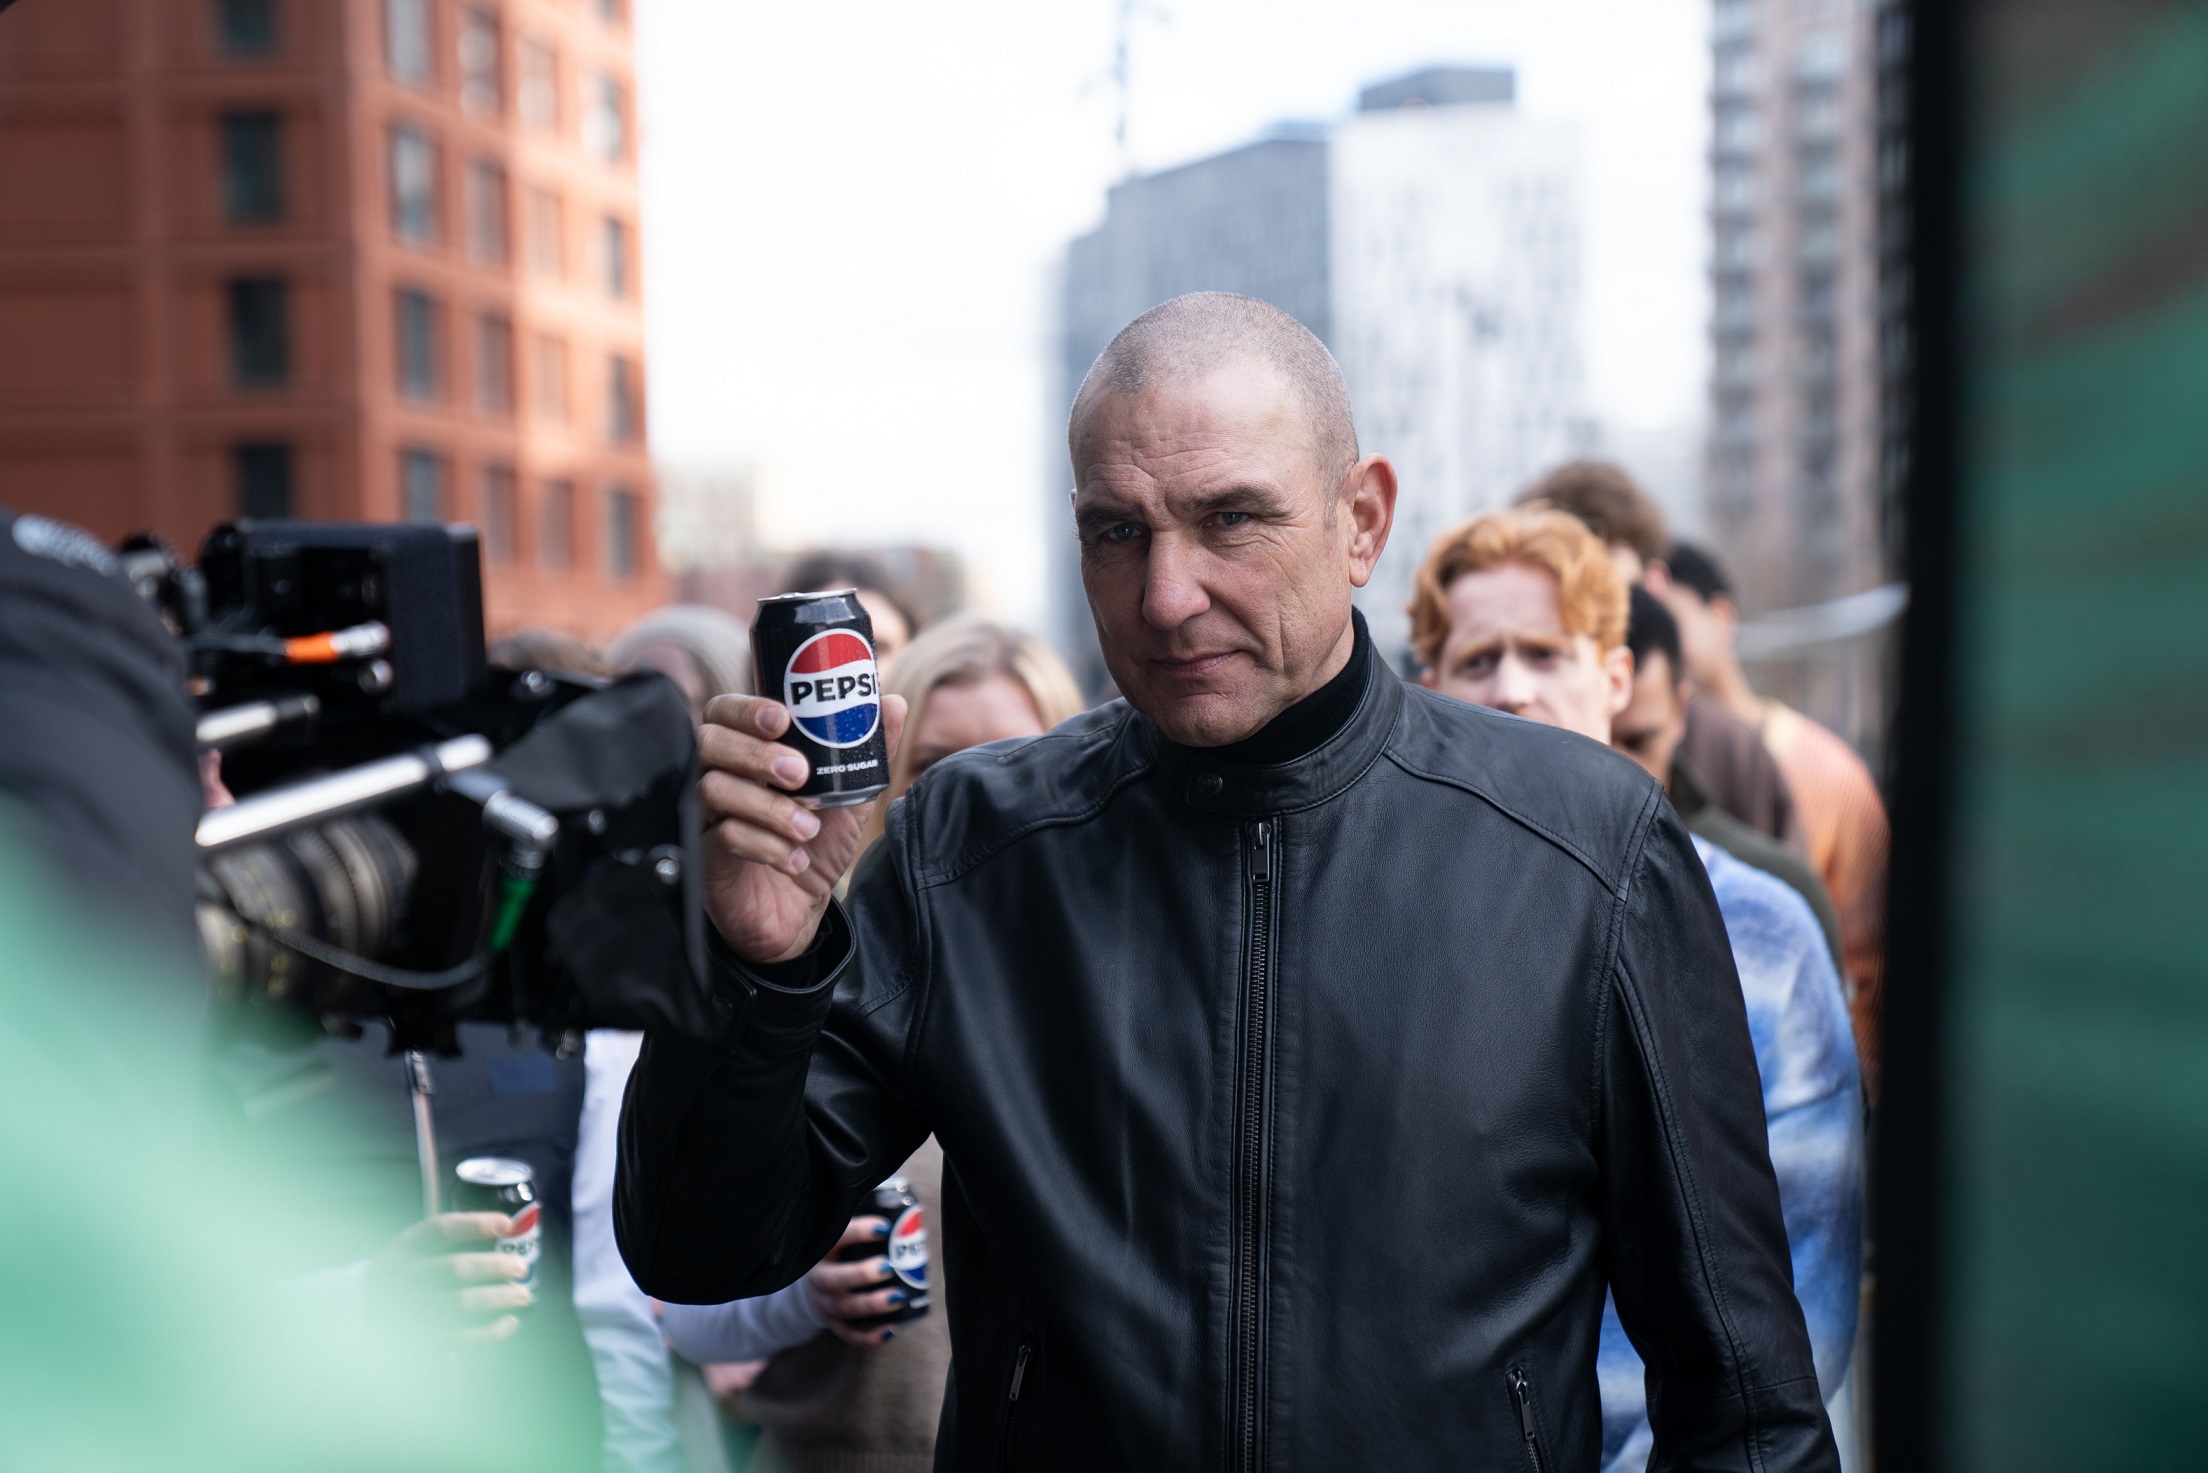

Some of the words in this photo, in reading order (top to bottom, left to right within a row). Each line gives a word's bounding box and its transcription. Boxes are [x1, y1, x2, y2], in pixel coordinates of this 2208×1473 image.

[790, 672, 877, 706] PEPSI
[816, 765, 846, 775] ZERO
[846, 759, 879, 772] SUGAR
